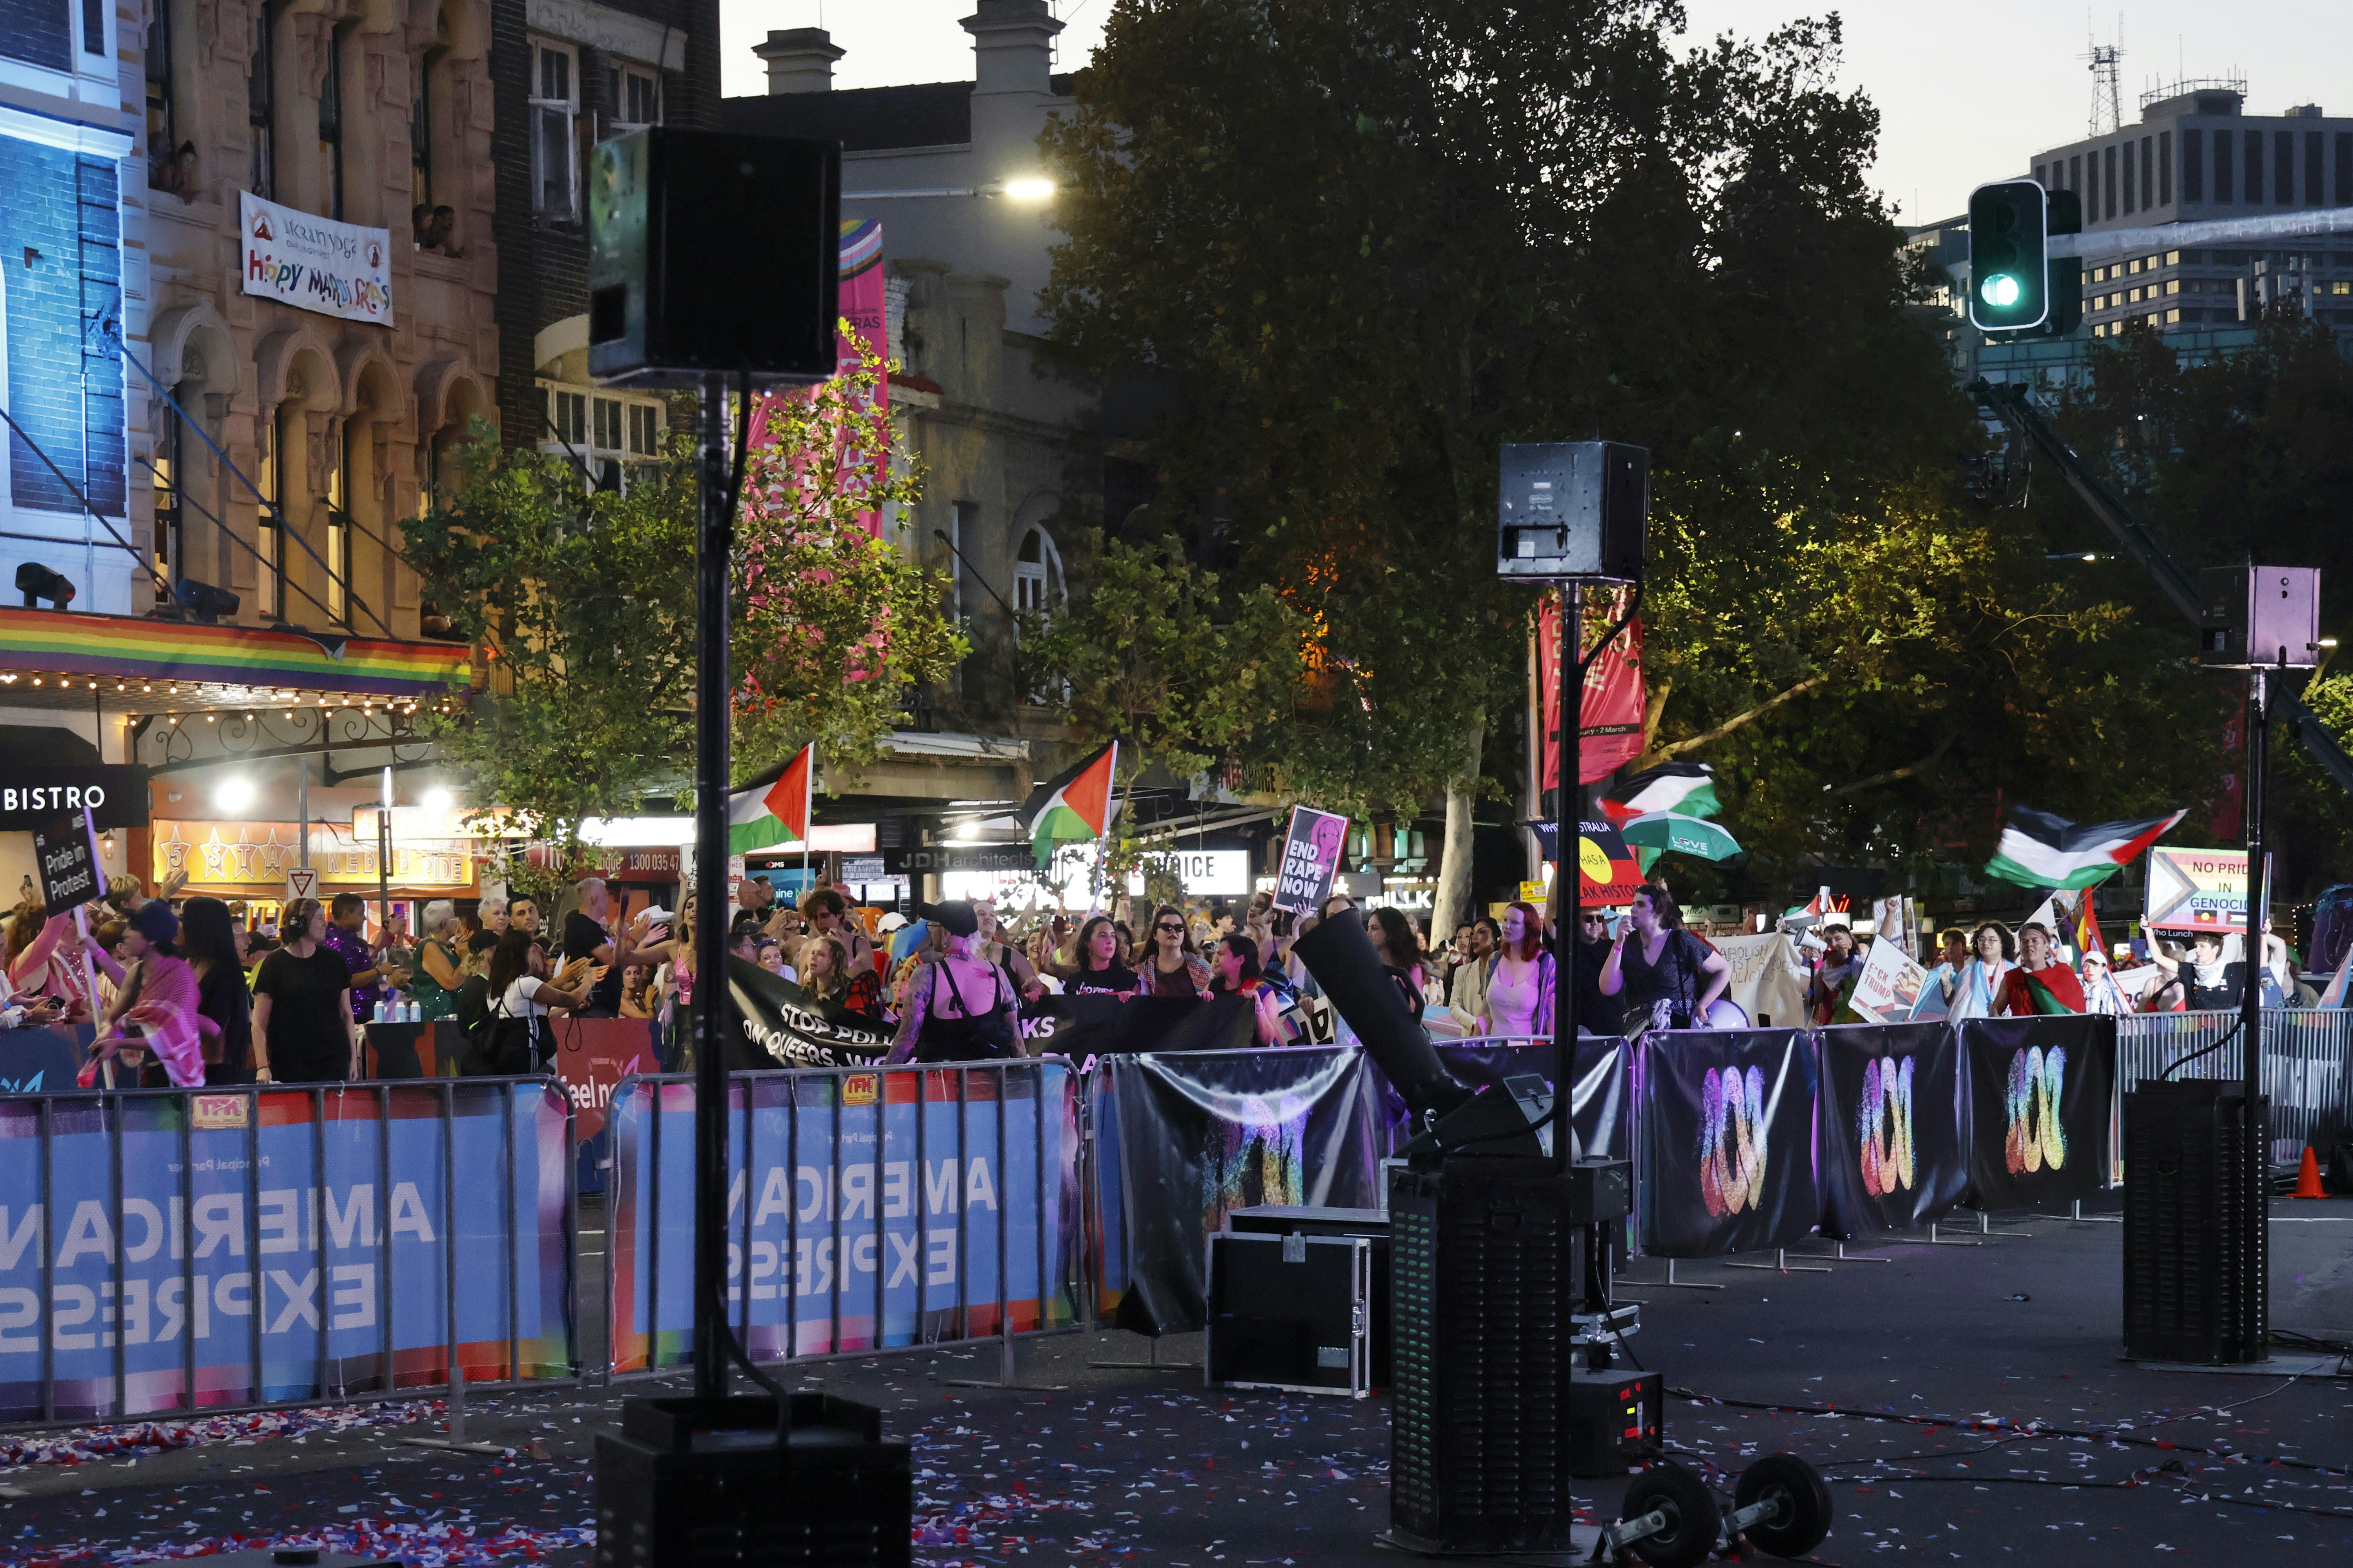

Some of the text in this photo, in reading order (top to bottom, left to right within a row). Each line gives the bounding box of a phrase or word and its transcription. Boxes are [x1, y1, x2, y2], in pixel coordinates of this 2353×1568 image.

[4, 785, 105, 811] BISTRO
[1537, 822, 1611, 833] WHI STRALIA
[427, 839, 466, 853] IZZA
[1289, 839, 1318, 861] END
[1673, 843, 1708, 855] PALESTINE
[45, 841, 86, 876] Pride in
[170, 842, 181, 867] 5
[327, 839, 411, 874] KEBB
[630, 854, 650, 871] 1300
[652, 854, 667, 871] 035
[670, 855, 679, 871] 47
[899, 852, 1033, 869] JDH architects
[1580, 855, 1606, 866] HAS A
[422, 856, 462, 881] PIDE
[1284, 858, 1322, 881] RAPE
[2193, 861, 2248, 875] NO PRID
[50, 867, 91, 901] Protest
[1280, 876, 1319, 899] NOW
[2218, 883, 2231, 892] IN
[2190, 897, 2247, 910] GENOCI
[2168, 930, 2193, 938] Lunch
[1720, 944, 1769, 960] ABOLISH
[1730, 969, 1775, 983] OLICIES
[1864, 974, 1891, 1000] TRUMP
[781, 1003, 831, 1034] STOP
[1021, 1016, 1056, 1039] KS
[743, 1019, 768, 1045] ON
